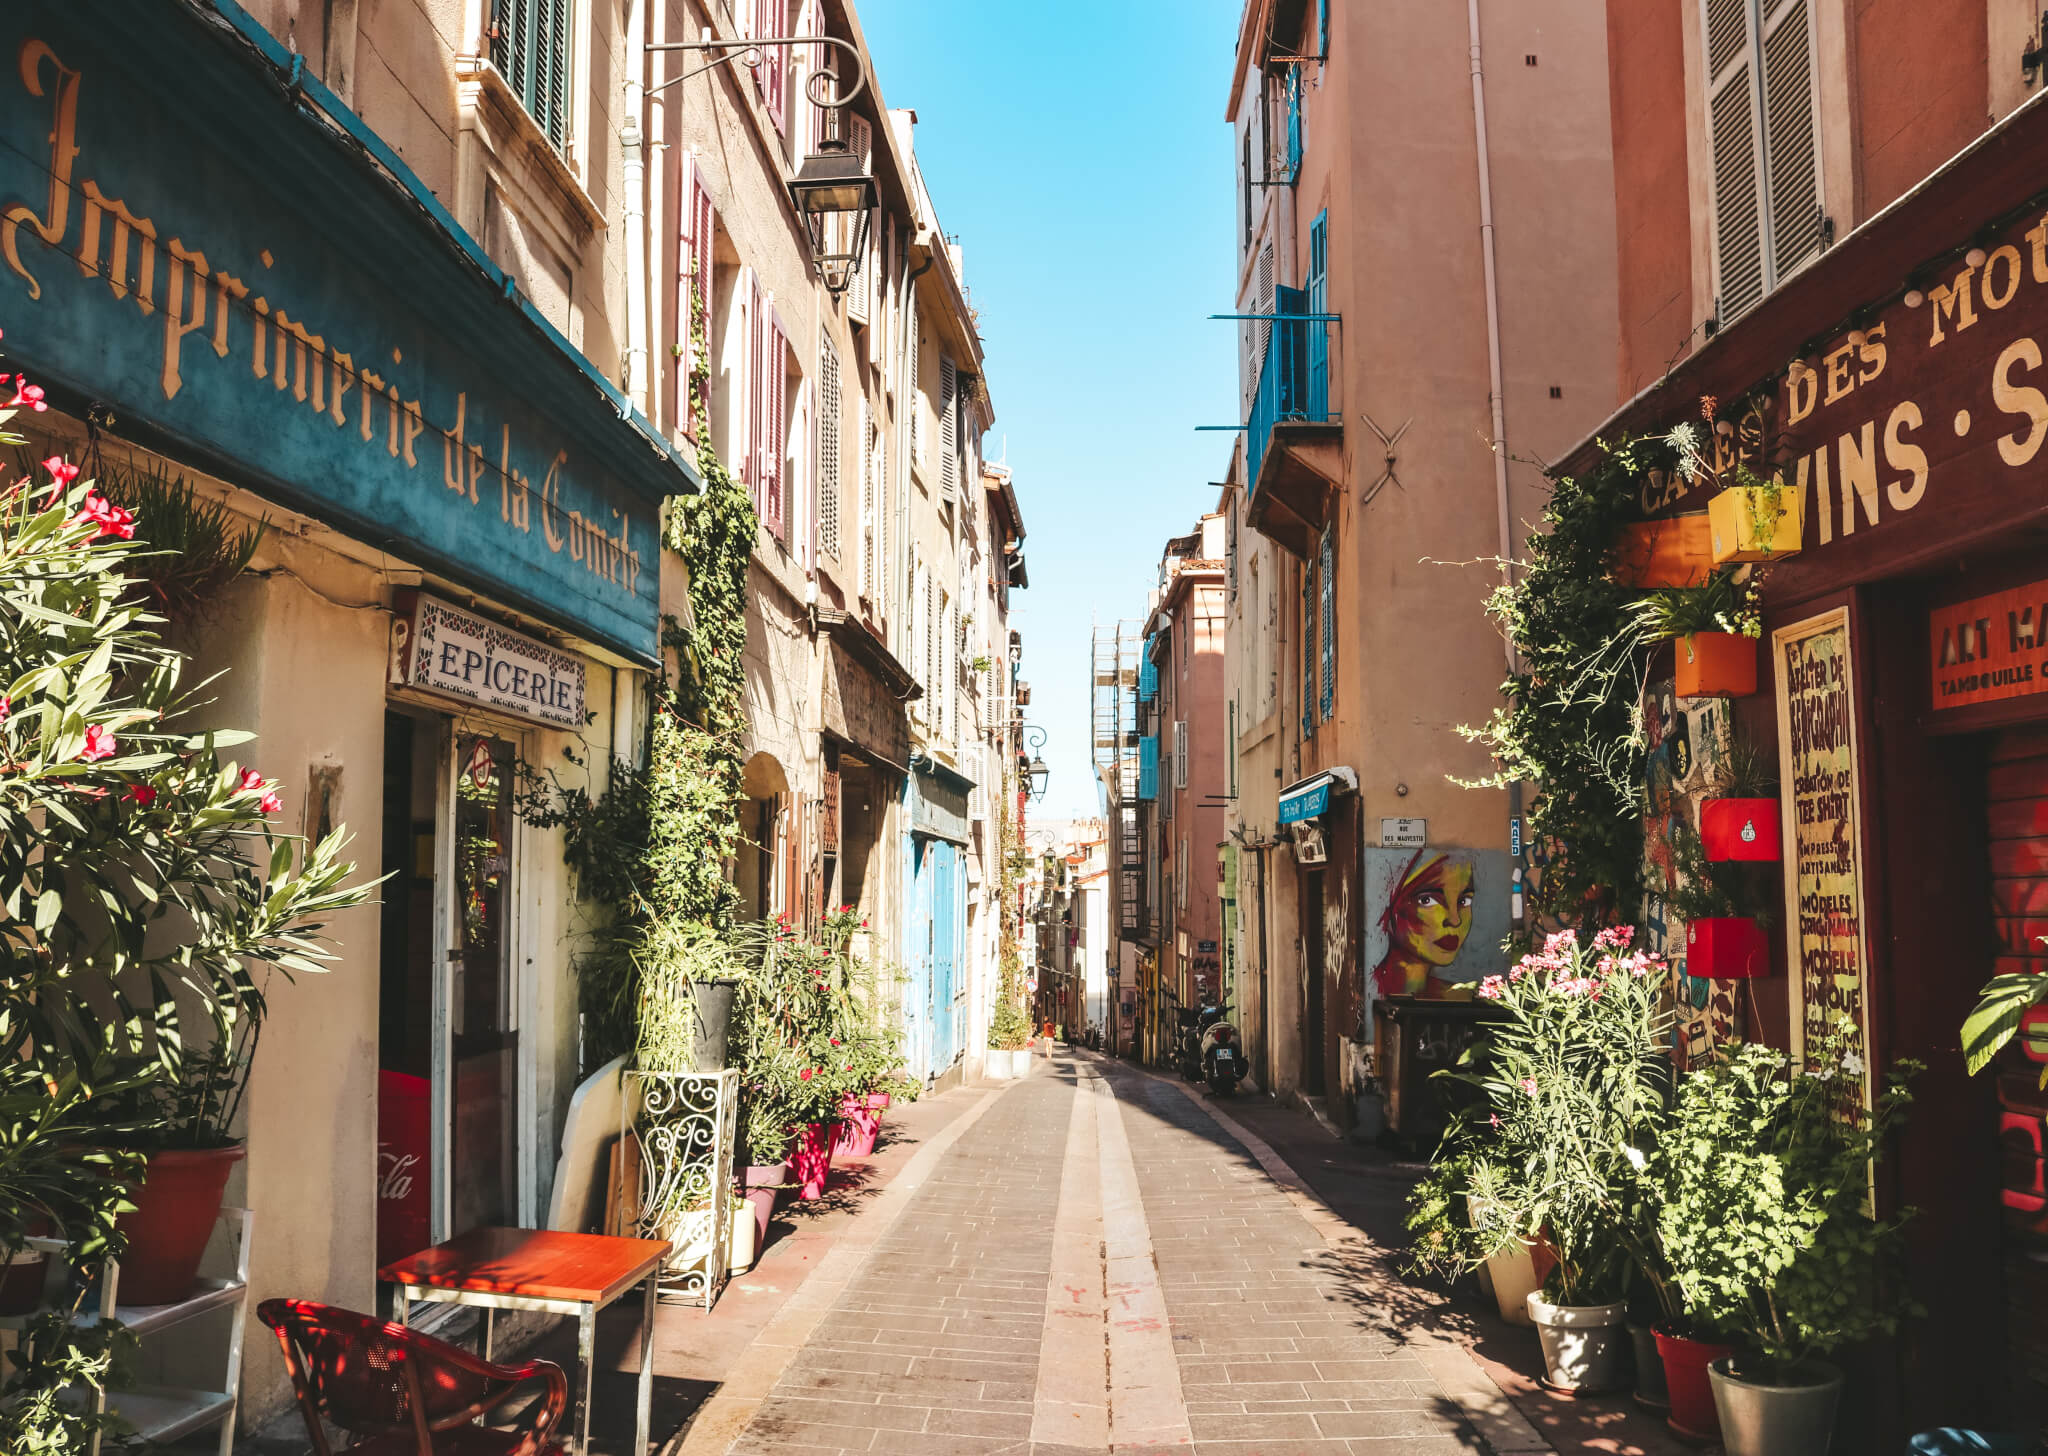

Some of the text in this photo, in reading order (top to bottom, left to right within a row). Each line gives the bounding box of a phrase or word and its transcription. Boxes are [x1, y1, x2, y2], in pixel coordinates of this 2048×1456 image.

[2, 39, 424, 469] Imprimerie
[443, 392, 486, 505] de
[501, 423, 530, 534] la
[1785, 321, 1888, 427] DES
[1830, 655, 1844, 683] DE
[1938, 617, 1991, 669] ART
[438, 641, 573, 714] EPICERIE
[1940, 664, 2033, 697] TAMBOUILLE
